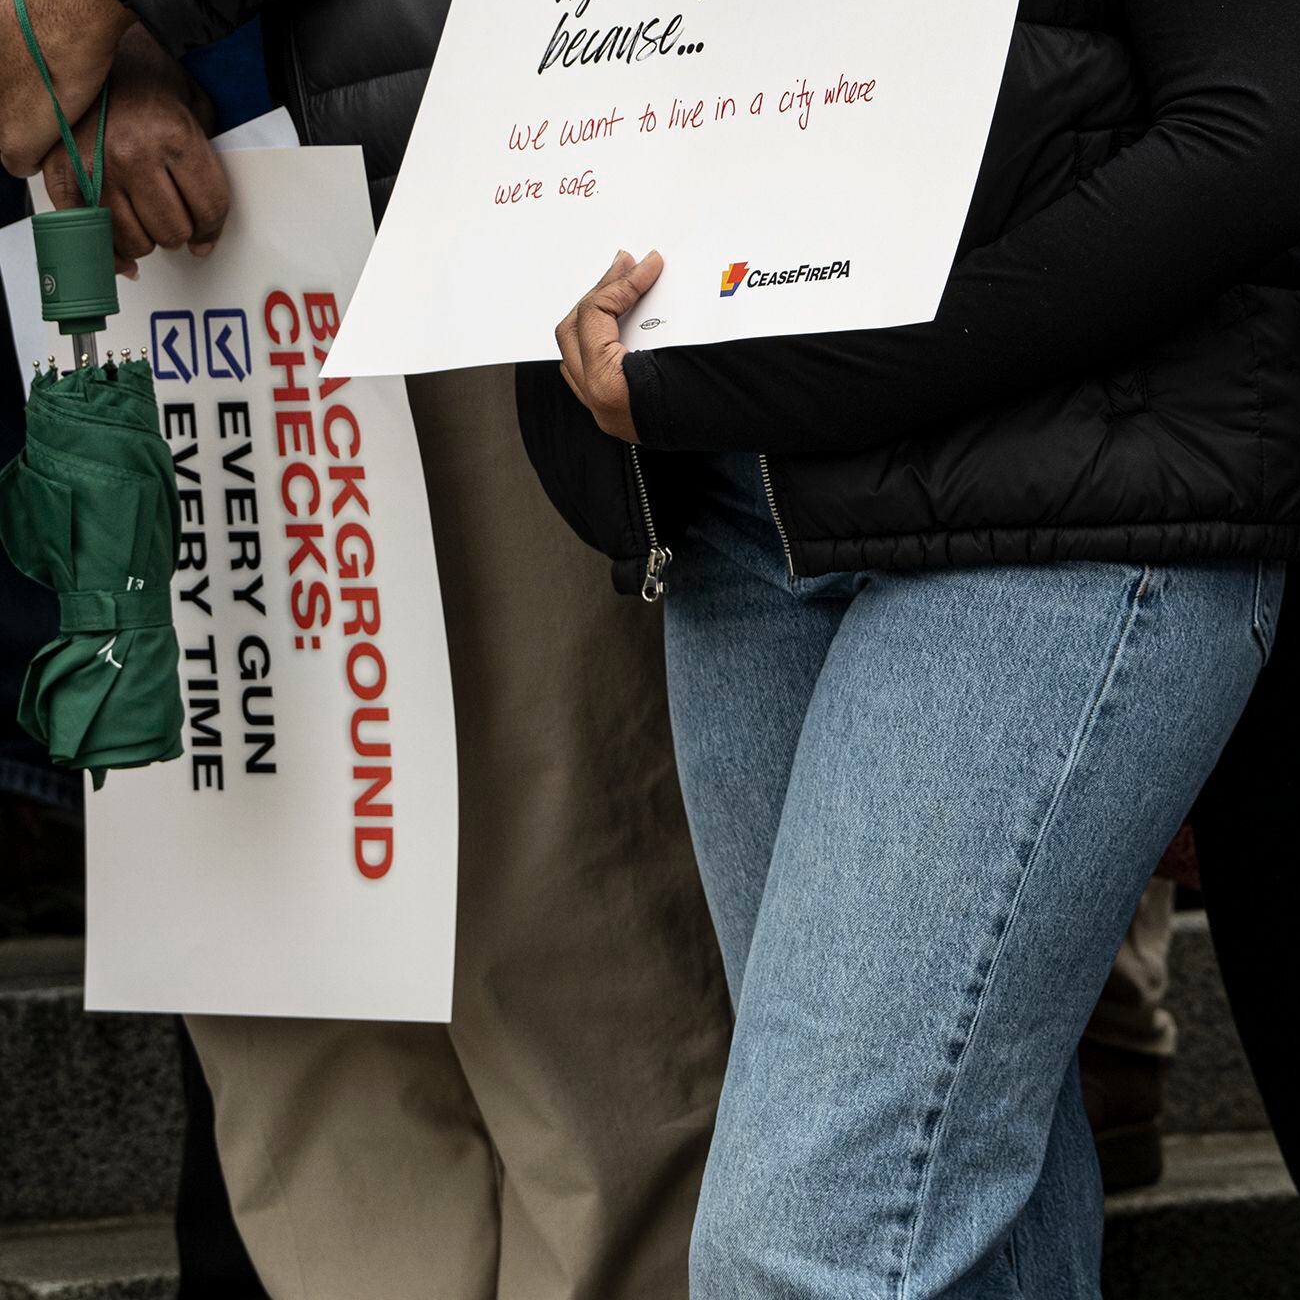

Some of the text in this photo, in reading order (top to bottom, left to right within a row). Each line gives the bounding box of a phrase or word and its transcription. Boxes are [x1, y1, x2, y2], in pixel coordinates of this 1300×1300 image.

[536, 12, 706, 76] because...
[558, 106, 626, 147] want
[638, 109, 658, 134] to
[668, 97, 705, 131] live
[714, 95, 737, 122] in
[749, 91, 764, 117] a
[778, 78, 816, 131] city
[823, 73, 878, 107] where
[494, 169, 600, 205] we're safe.
[263, 289, 333, 651] CHECKS:
[163, 402, 225, 792] EVERY TIME
[217, 401, 278, 774] EVERY GUN
